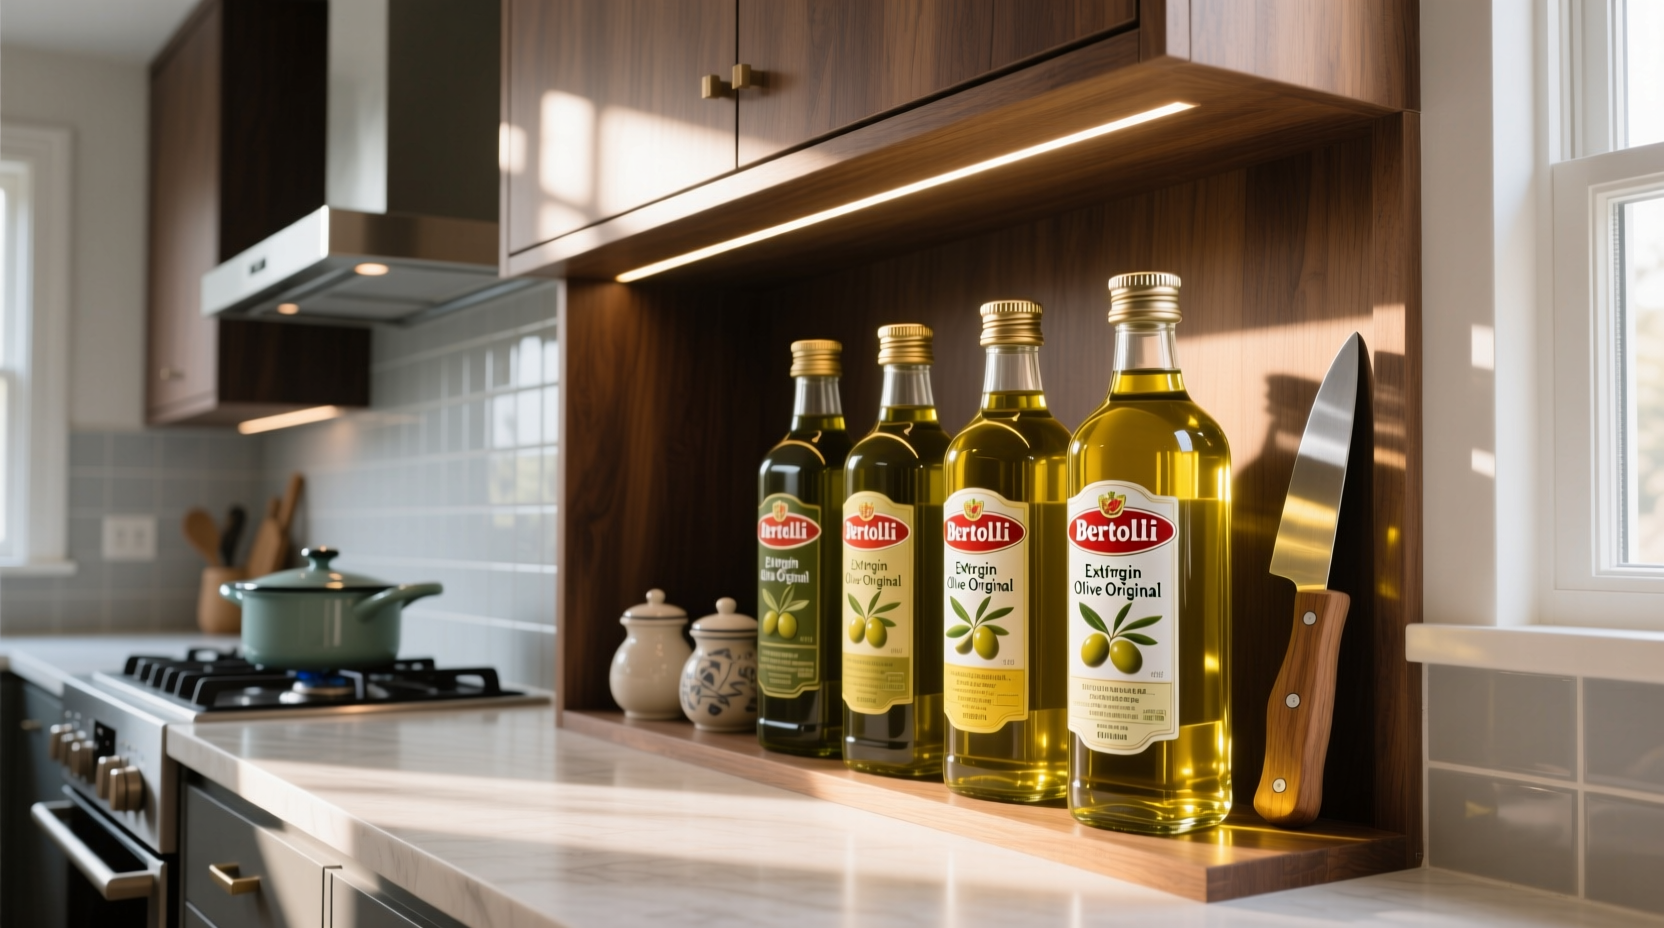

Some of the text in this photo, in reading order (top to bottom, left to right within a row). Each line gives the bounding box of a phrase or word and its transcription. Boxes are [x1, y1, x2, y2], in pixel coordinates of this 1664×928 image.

[846, 521, 897, 541] Bertolli
[947, 521, 1010, 542] Bertolli
[1075, 518, 1158, 542] Bertolli
[1074, 580, 1162, 601] Olive Original
